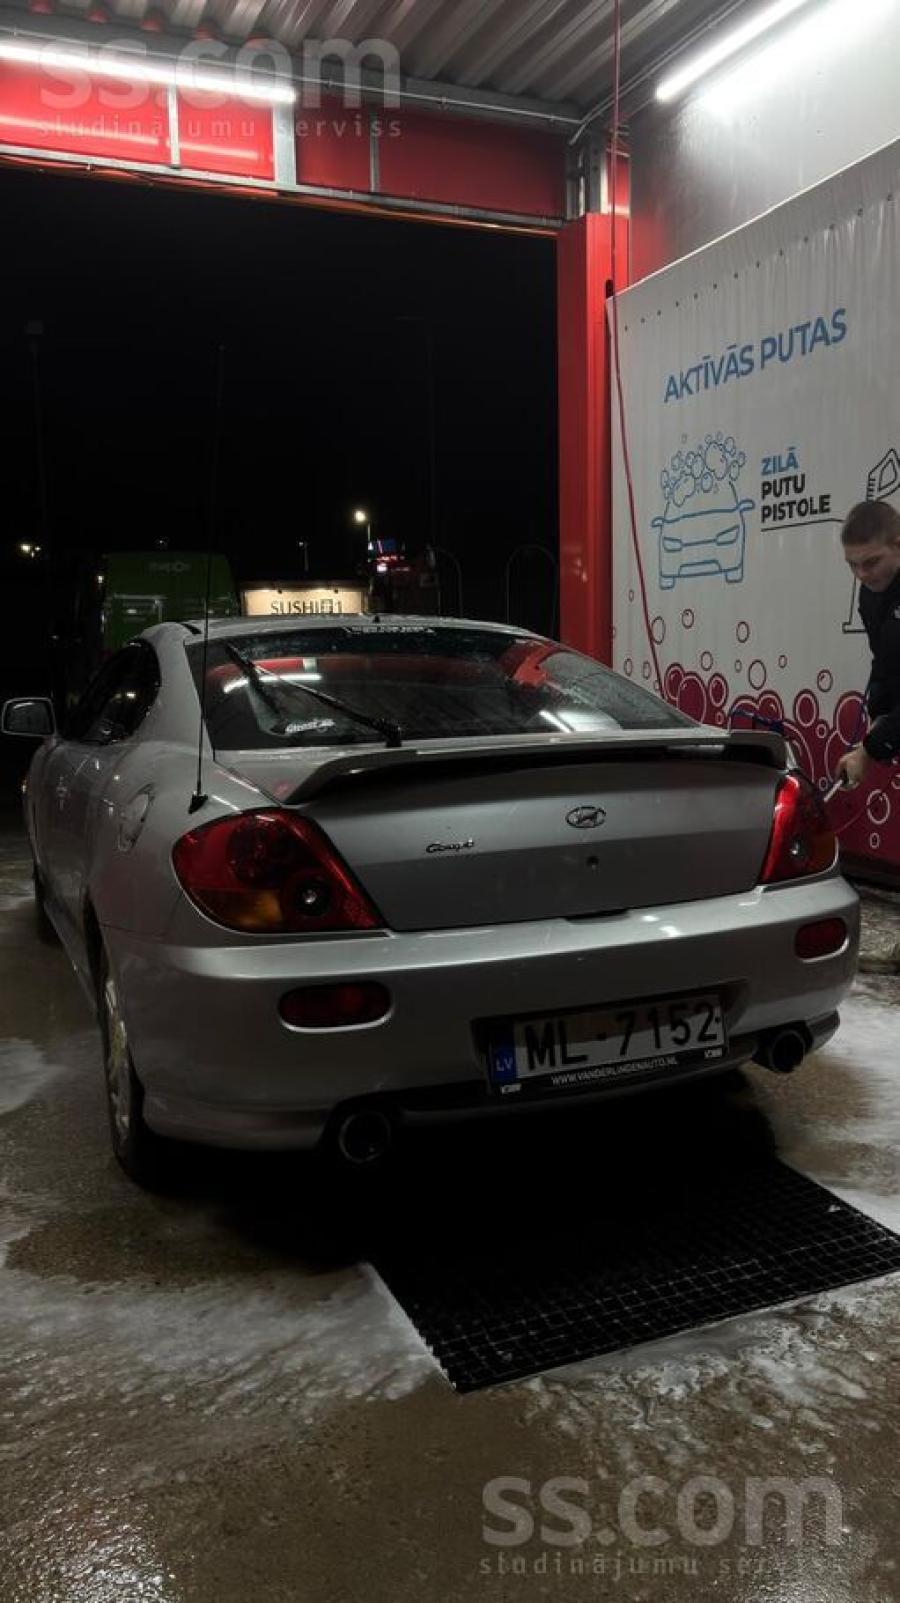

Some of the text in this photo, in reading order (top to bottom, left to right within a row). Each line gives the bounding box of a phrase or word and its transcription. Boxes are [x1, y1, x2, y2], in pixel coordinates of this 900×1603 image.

[664, 308, 847, 403] AKTĪVĀS PUTAS
[761, 447, 798, 475] ZILĀ
[761, 474, 806, 500] PUTU
[761, 494, 831, 523] PISTOLE
[495, 1058, 513, 1073] LV
